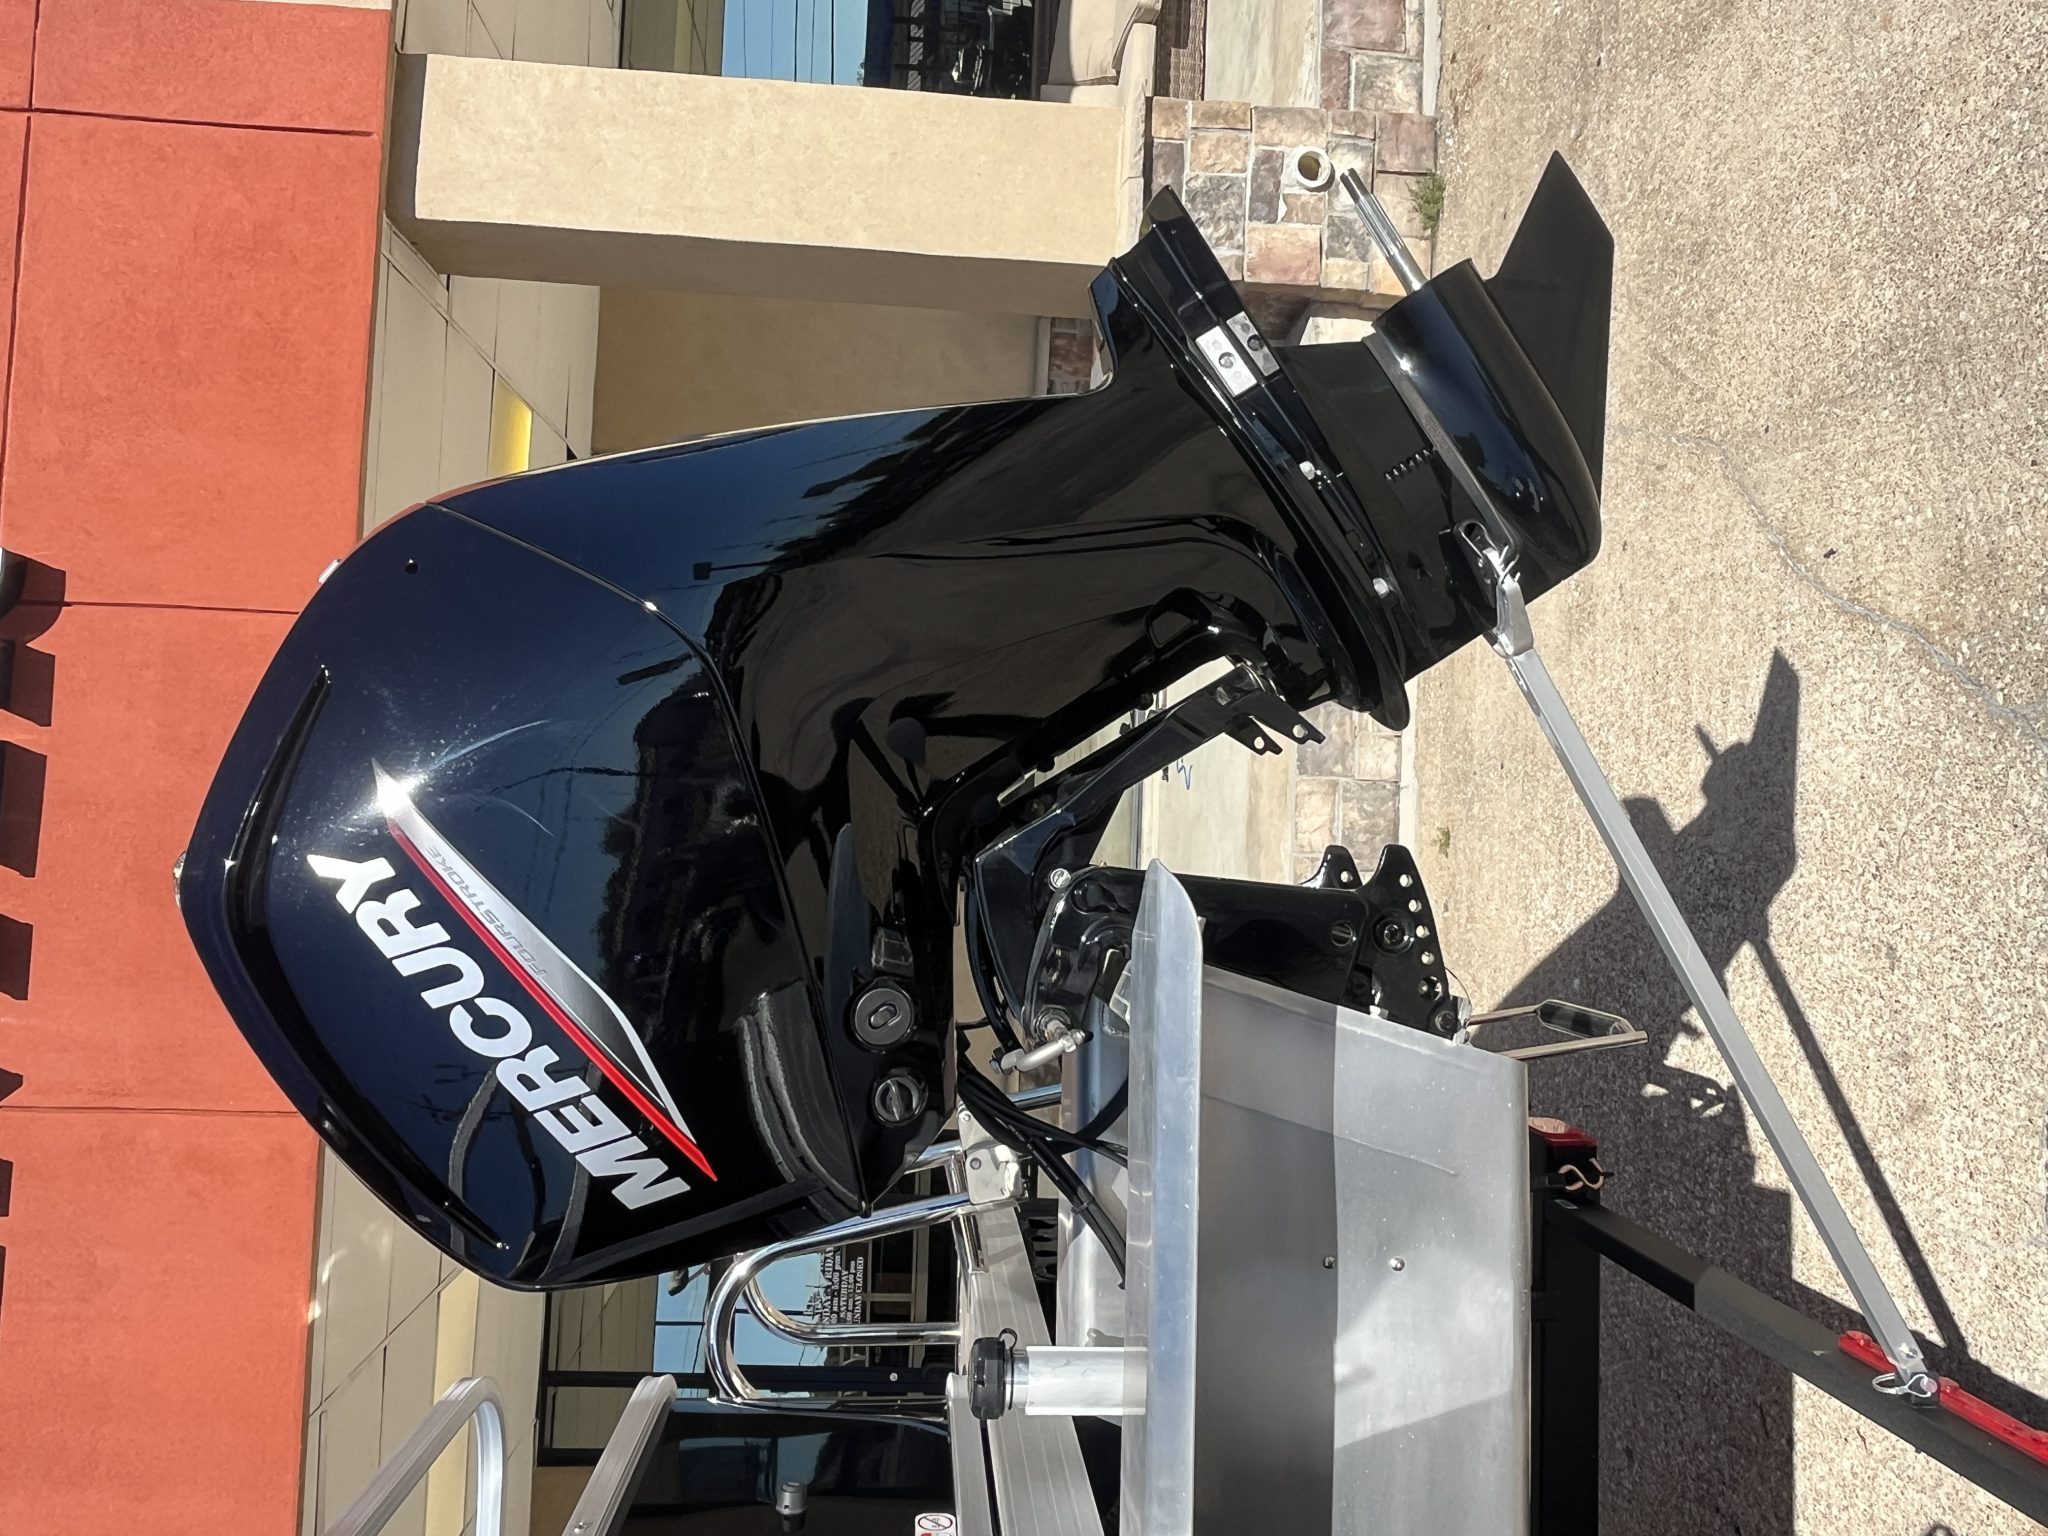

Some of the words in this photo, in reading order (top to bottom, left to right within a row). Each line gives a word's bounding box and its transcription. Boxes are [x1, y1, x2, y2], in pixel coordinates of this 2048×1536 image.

[425, 844, 547, 979] FOURSTROKE
[307, 854, 691, 1211] MERCURY
[840, 1269, 848, 1319] SATURDAY
[855, 1257, 864, 1293] CLOSED
